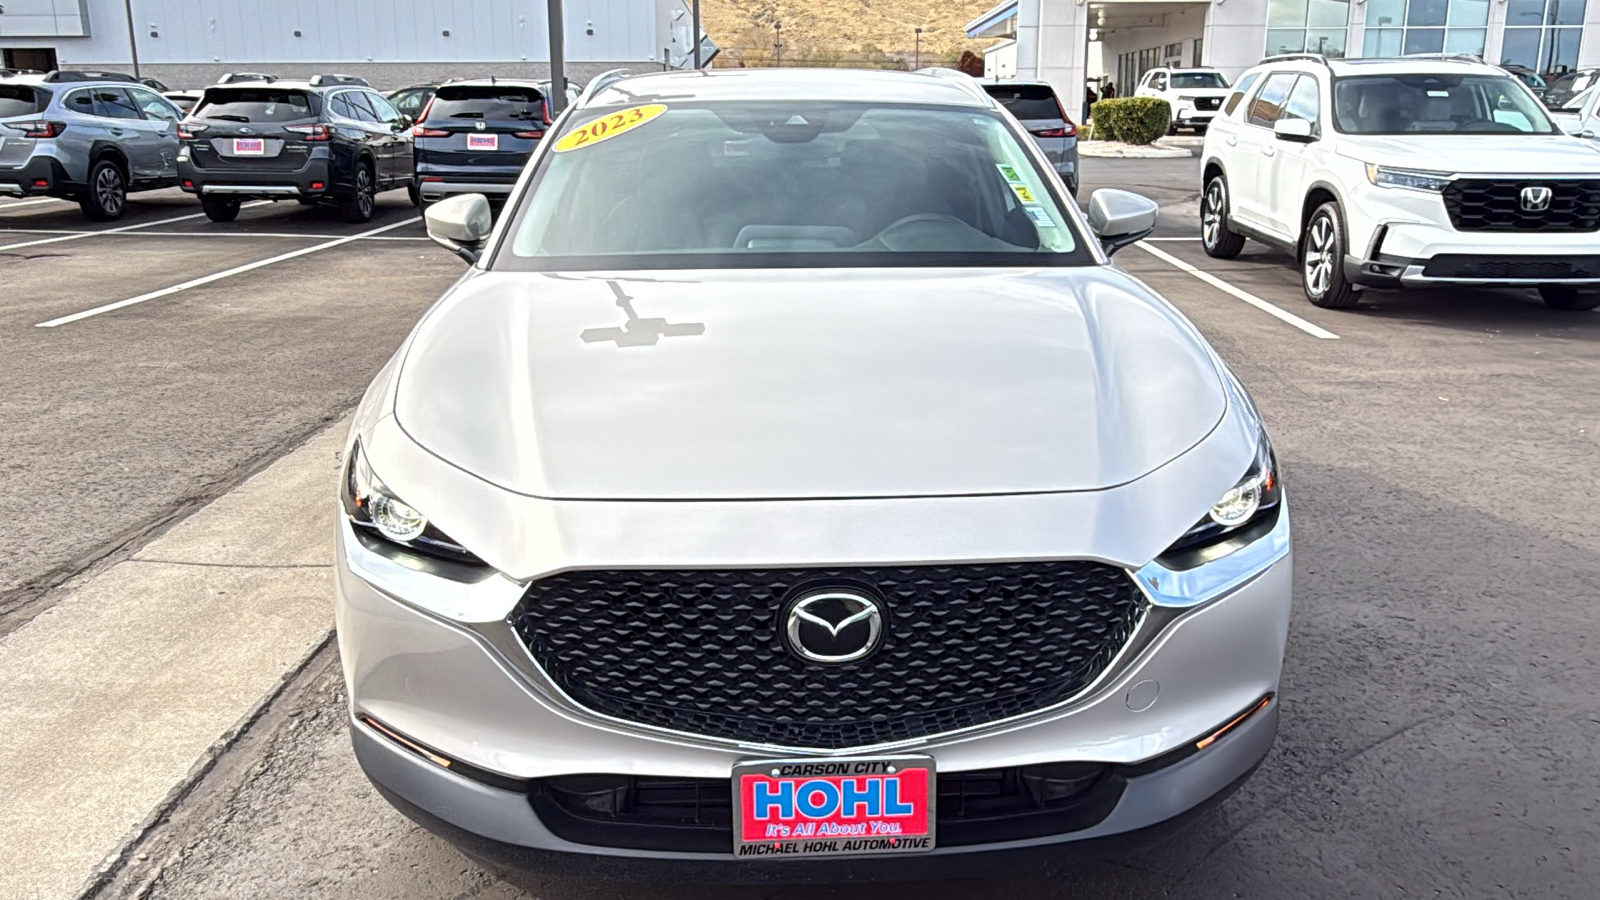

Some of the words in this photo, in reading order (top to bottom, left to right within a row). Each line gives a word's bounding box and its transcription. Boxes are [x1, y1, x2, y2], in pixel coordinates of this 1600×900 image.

[573, 108, 644, 146] 2023
[780, 762, 848, 776] CARSON
[854, 761, 891, 774] CITY
[754, 777, 914, 820] HOHL
[765, 823, 790, 837] It's
[793, 822, 814, 836] All
[818, 821, 866, 835] About
[870, 820, 902, 834] You.
[739, 842, 800, 856] MICHAEL
[803, 841, 839, 853] HOHL
[842, 837, 931, 851] AUTOMOTIVE
